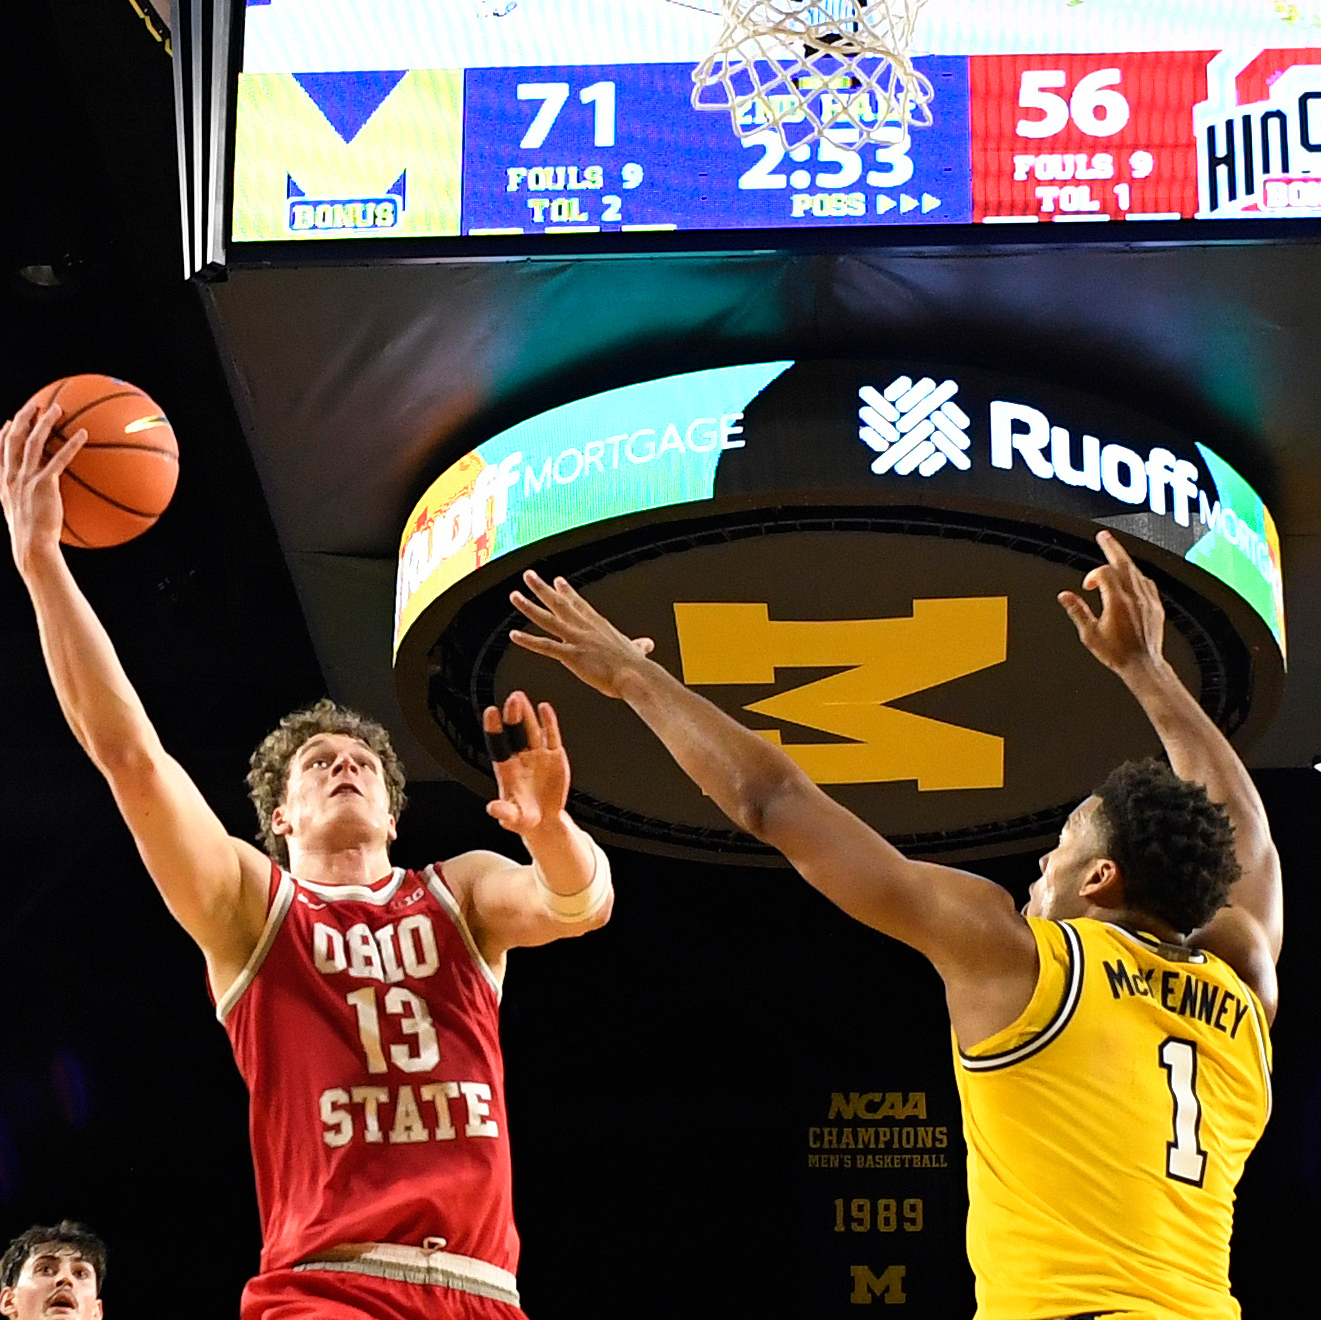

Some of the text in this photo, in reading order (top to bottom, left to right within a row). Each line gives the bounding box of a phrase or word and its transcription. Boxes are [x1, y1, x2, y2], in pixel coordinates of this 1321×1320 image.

[517, 81, 616, 149] 71
[1015, 68, 1130, 139] 56
[738, 126, 915, 189] 2:53
[1012, 150, 1154, 182] FOULS 9
[506, 162, 645, 193] FOULS 9
[291, 199, 397, 231] BONUS
[527, 195, 623, 224] TOL 2
[791, 192, 867, 218] POSS
[1035, 183, 1130, 213] TOL 1
[523, 412, 746, 498] MORTGAGE
[989, 399, 1199, 528] Ruoff
[312, 913, 440, 984] OHIO
[346, 985, 441, 1075] 13
[318, 1081, 500, 1149] STATE
[828, 1092, 928, 1120] NCAA
[1157, 1035, 1208, 1189] 1
[808, 1127, 949, 1150] CHAMPIONS
[808, 1154, 949, 1169] MEN'S BASKETBALL
[834, 1198, 925, 1233] 1989
[850, 1265, 907, 1305] M
